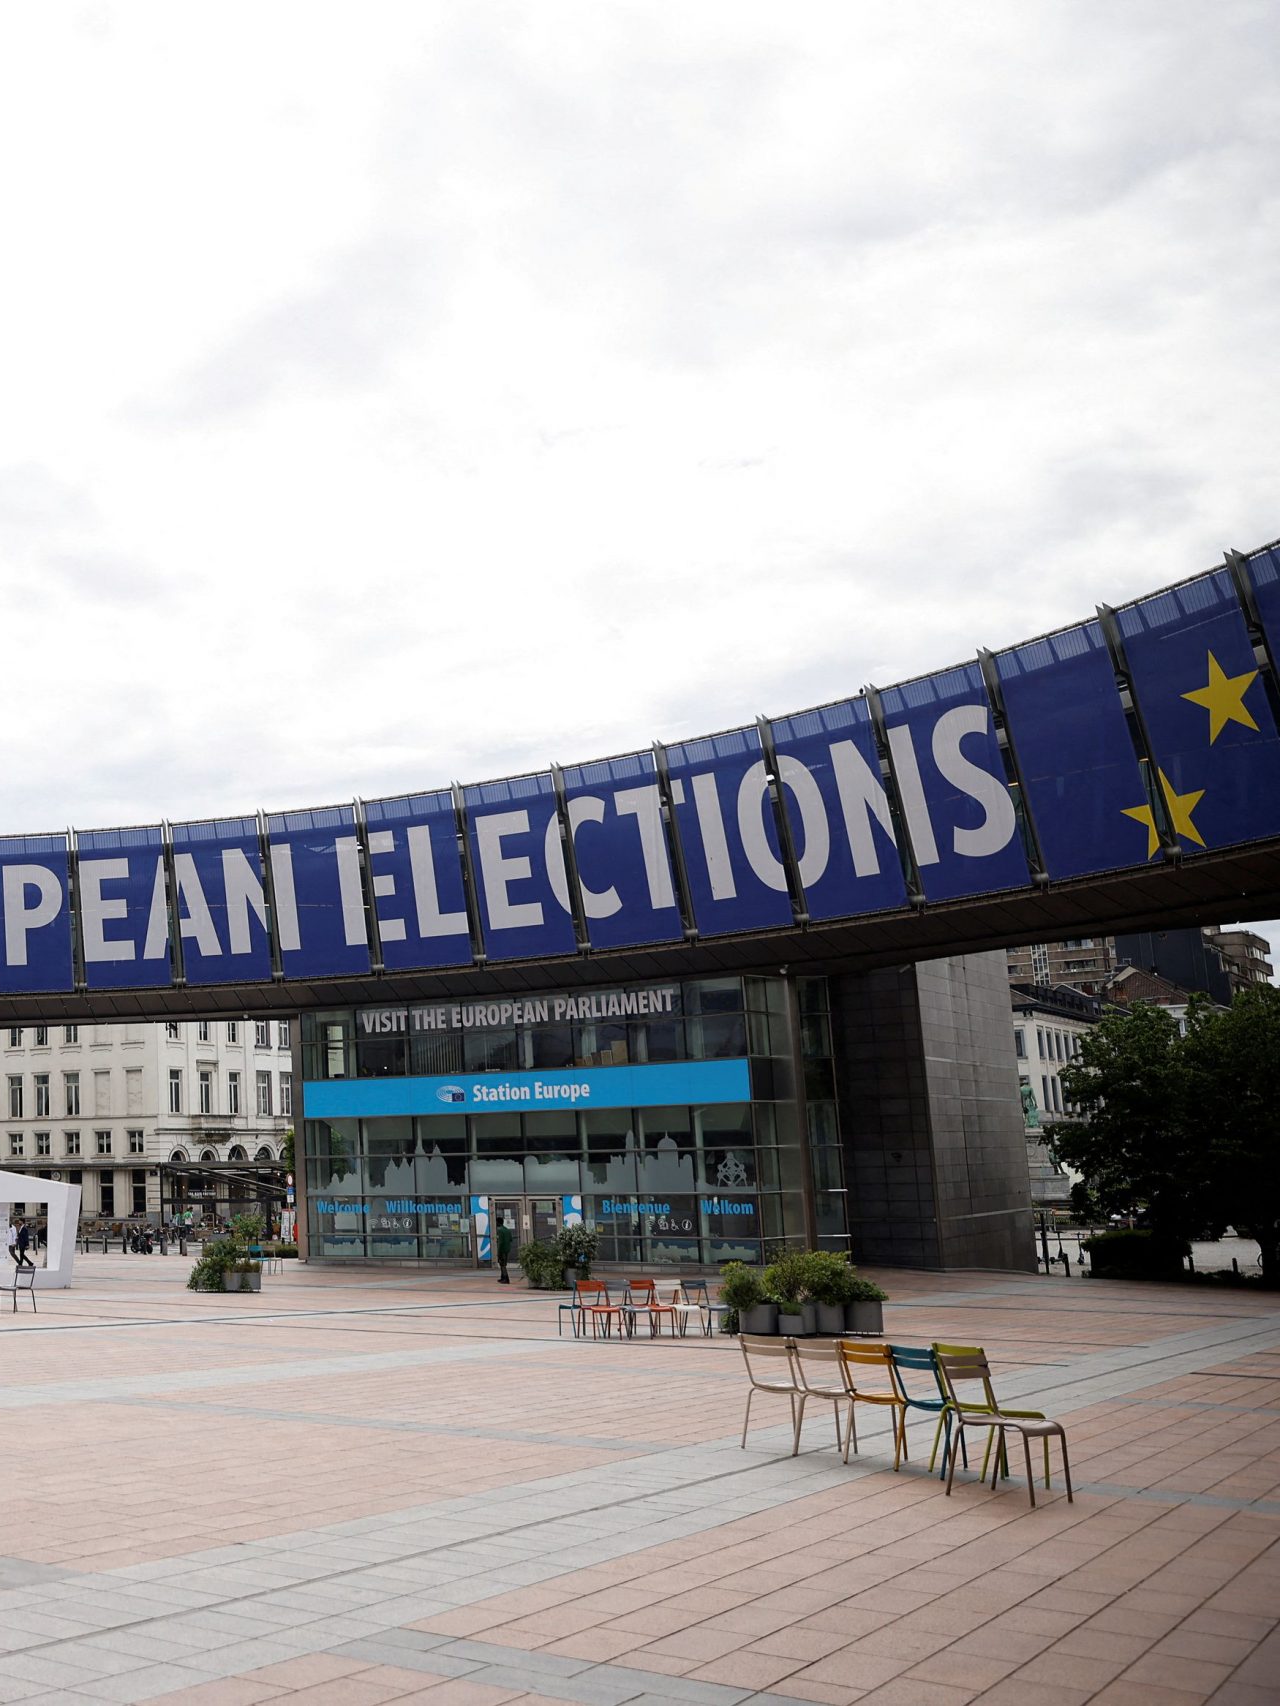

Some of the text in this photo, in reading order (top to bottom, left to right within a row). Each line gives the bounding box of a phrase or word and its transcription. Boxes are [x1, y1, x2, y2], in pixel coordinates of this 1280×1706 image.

[334, 704, 1017, 946] ELECTIONS
[362, 988, 675, 1034] VISIT THE EUROPEAN PARLIAMENT
[472, 1080, 590, 1103] Station Europe
[317, 1200, 754, 1215] Welcome Willkommen Bienvenue Welkom
